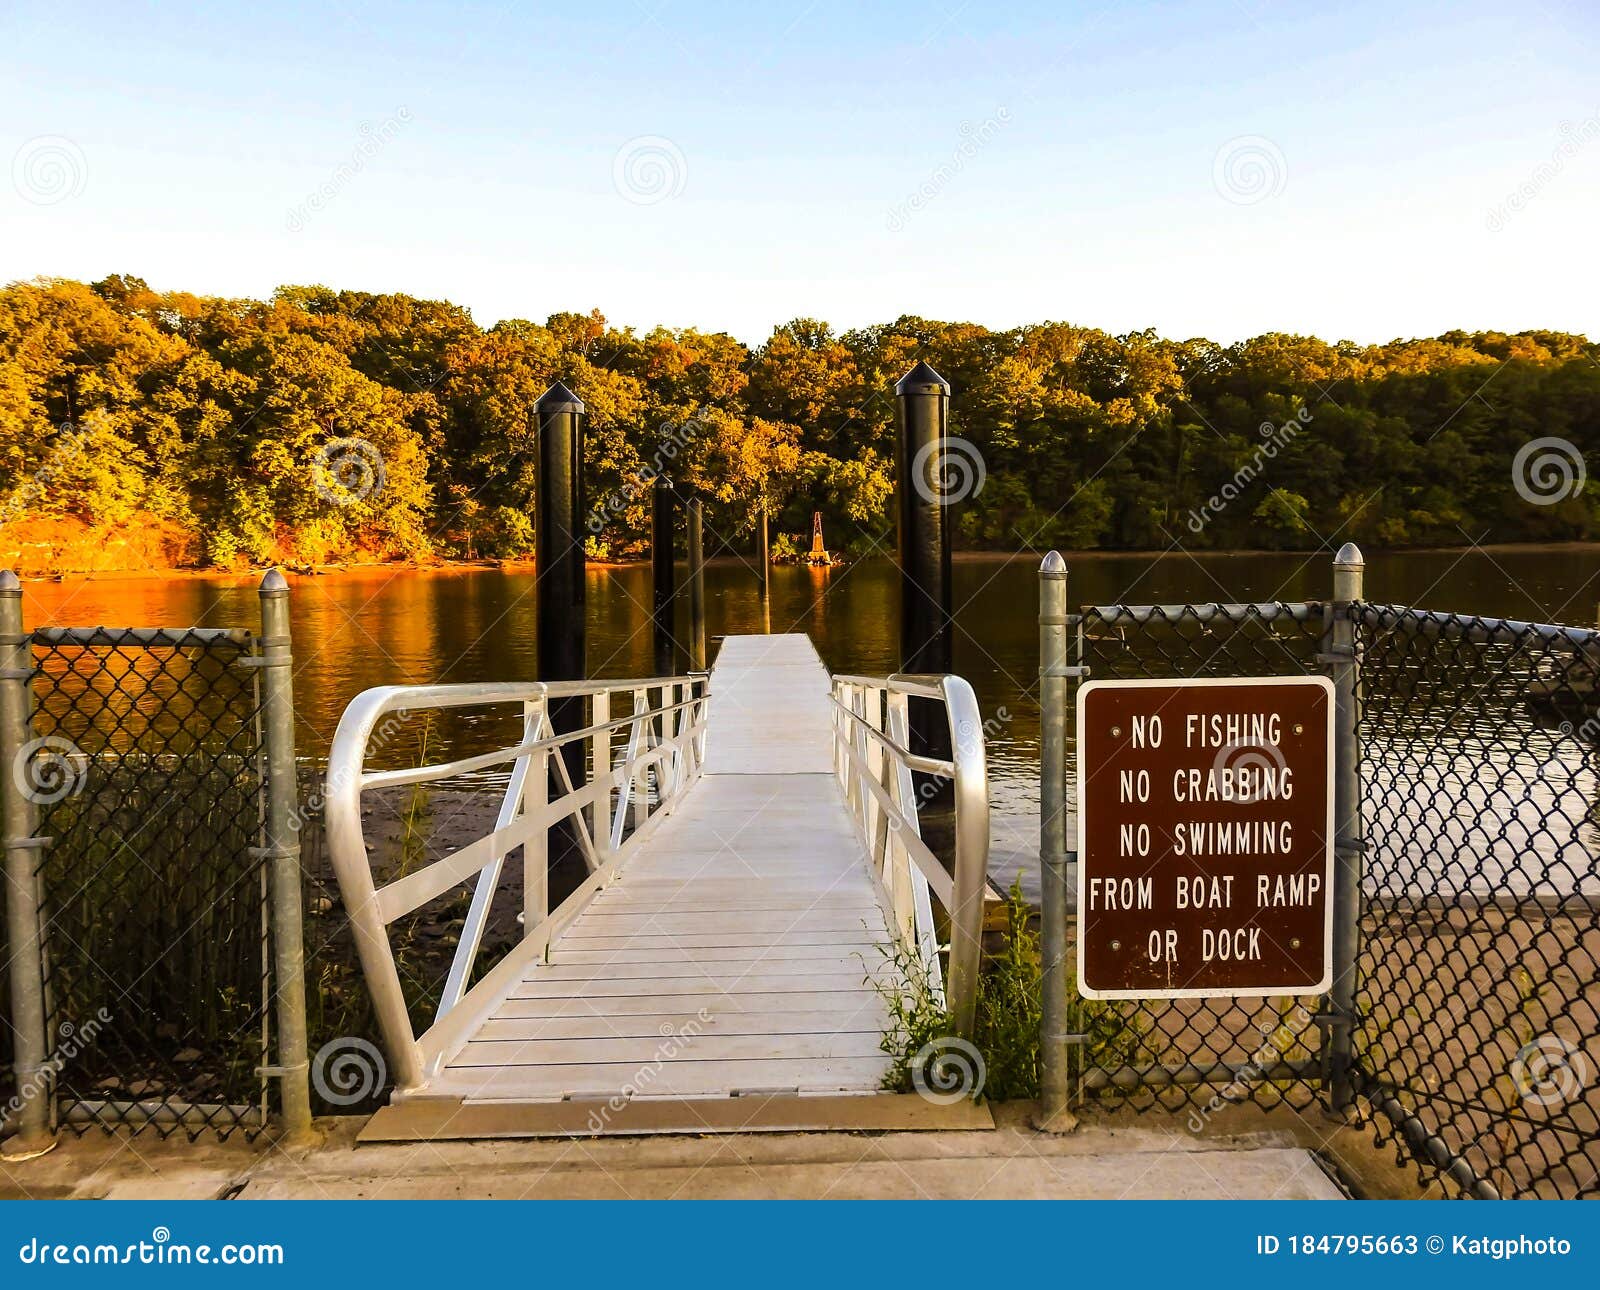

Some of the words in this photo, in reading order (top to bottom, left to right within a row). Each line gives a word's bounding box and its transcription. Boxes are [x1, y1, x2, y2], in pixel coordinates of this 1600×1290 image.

[1132, 715, 1162, 748] NO
[1186, 713, 1281, 748] FISHING
[1120, 770, 1150, 803] NO
[1173, 767, 1293, 802] CRABBING
[1120, 824, 1150, 857] NO
[1174, 821, 1292, 856] SWIMMING
[1090, 877, 1153, 911] FROM
[1176, 875, 1234, 909] BOAT
[1257, 873, 1321, 907] RAMP
[1148, 930, 1178, 962] OR
[1202, 928, 1262, 961] DOCK
